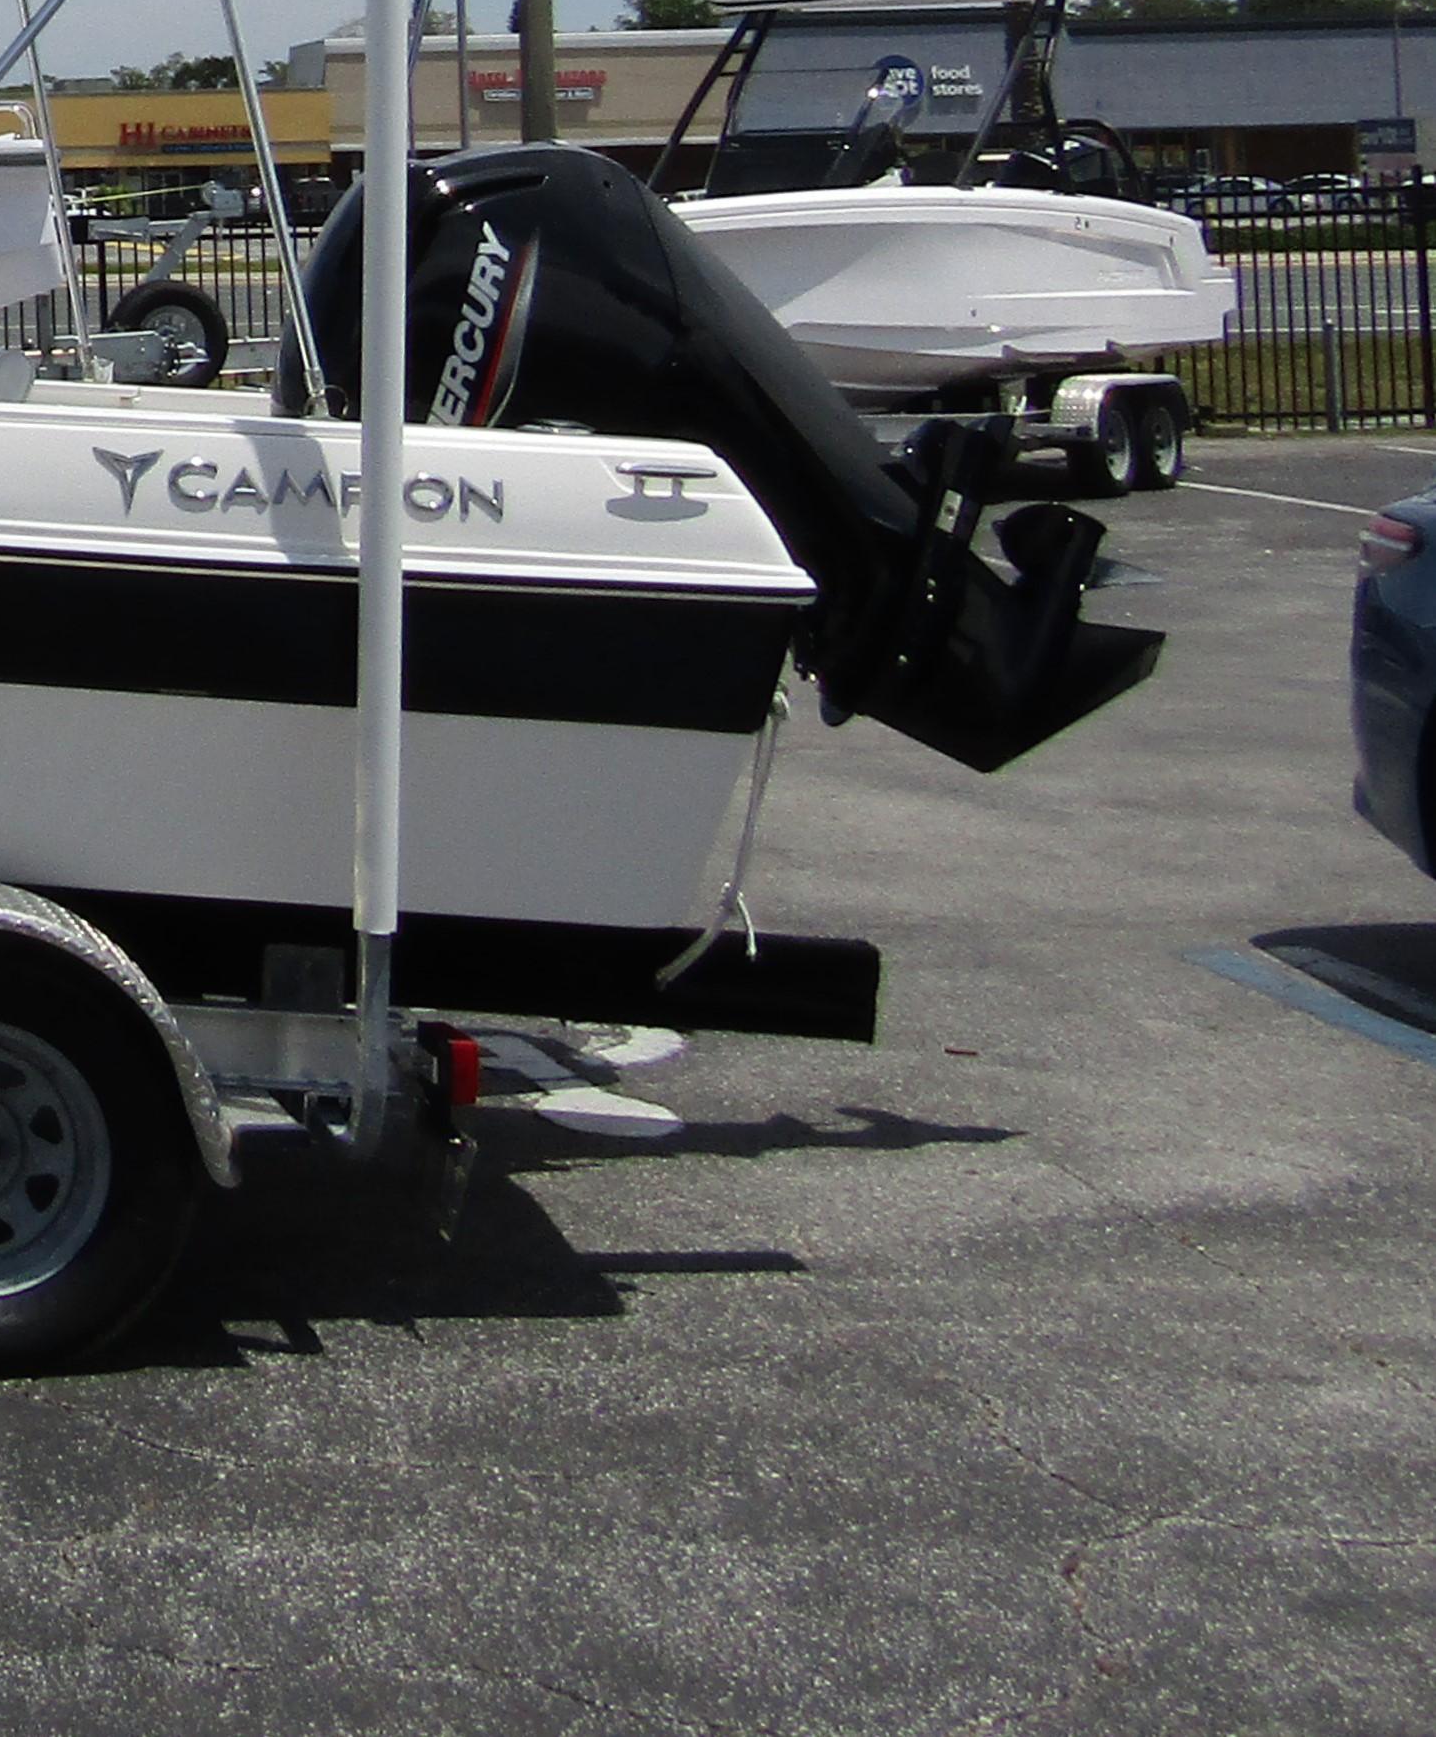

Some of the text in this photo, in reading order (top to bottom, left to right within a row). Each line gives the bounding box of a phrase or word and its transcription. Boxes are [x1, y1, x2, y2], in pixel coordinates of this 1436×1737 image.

[931, 65, 970, 79] food
[932, 83, 984, 96] stores
[167, 457, 504, 524] CAMPON
